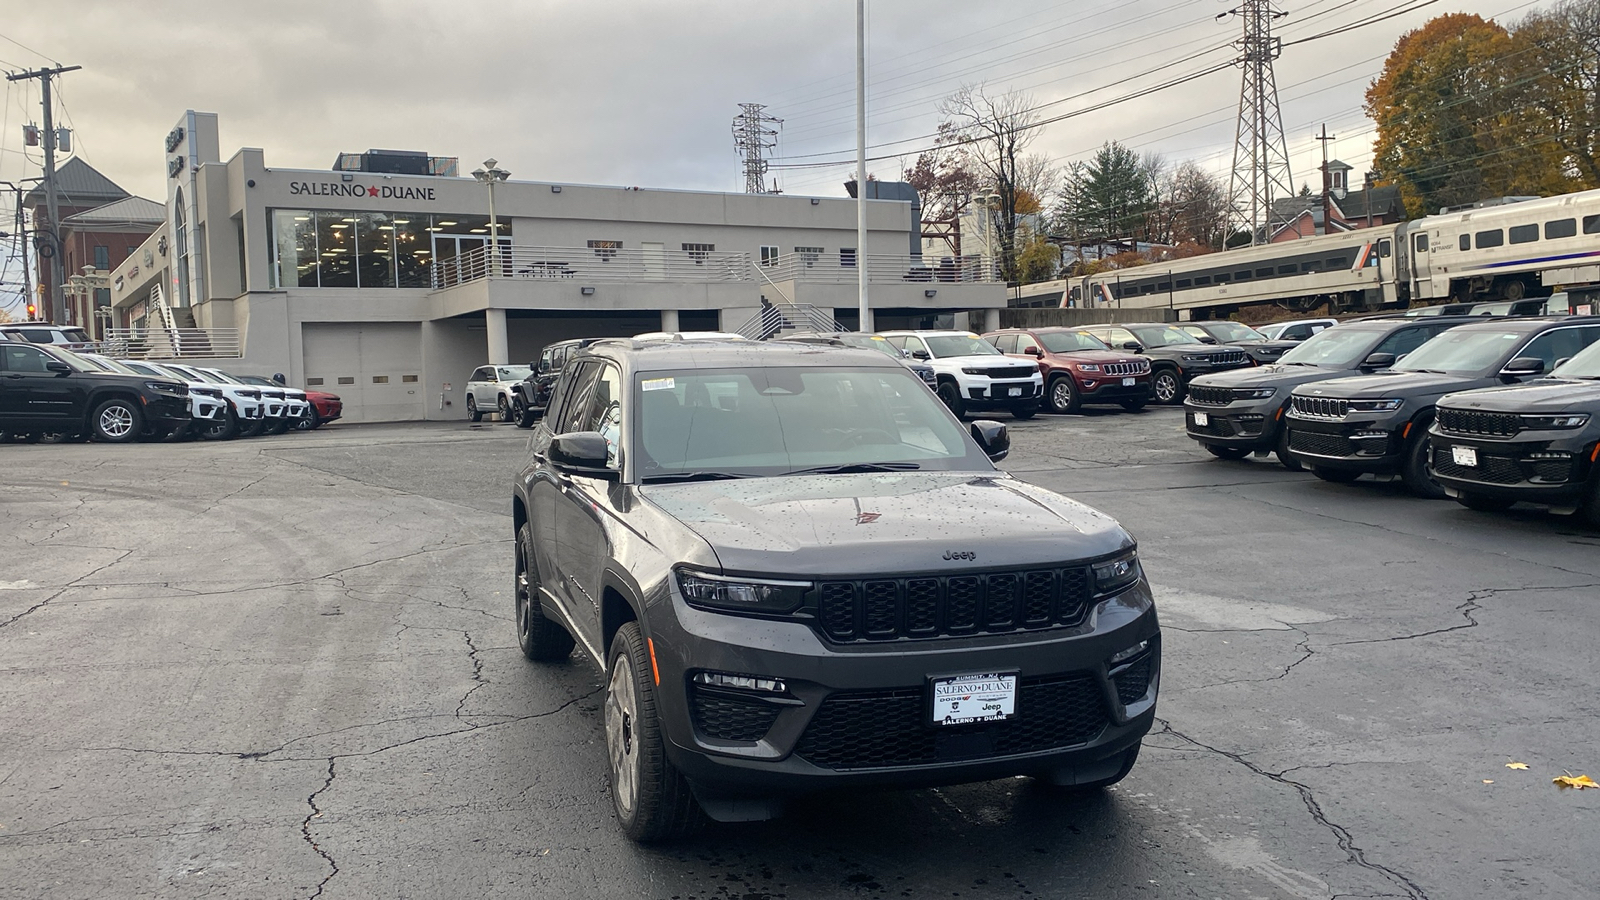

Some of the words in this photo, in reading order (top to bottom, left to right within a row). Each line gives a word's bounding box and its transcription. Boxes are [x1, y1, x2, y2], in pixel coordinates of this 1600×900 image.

[290, 181, 366, 198] SALERNO
[381, 185, 436, 201] DUANE
[942, 549, 976, 561] Jeep
[936, 684, 977, 695] SALERNO
[981, 682, 1012, 692] DUANE
[982, 703, 1001, 711] Jeep
[942, 717, 974, 726] SALERNO
[984, 714, 1007, 722] DUANE
